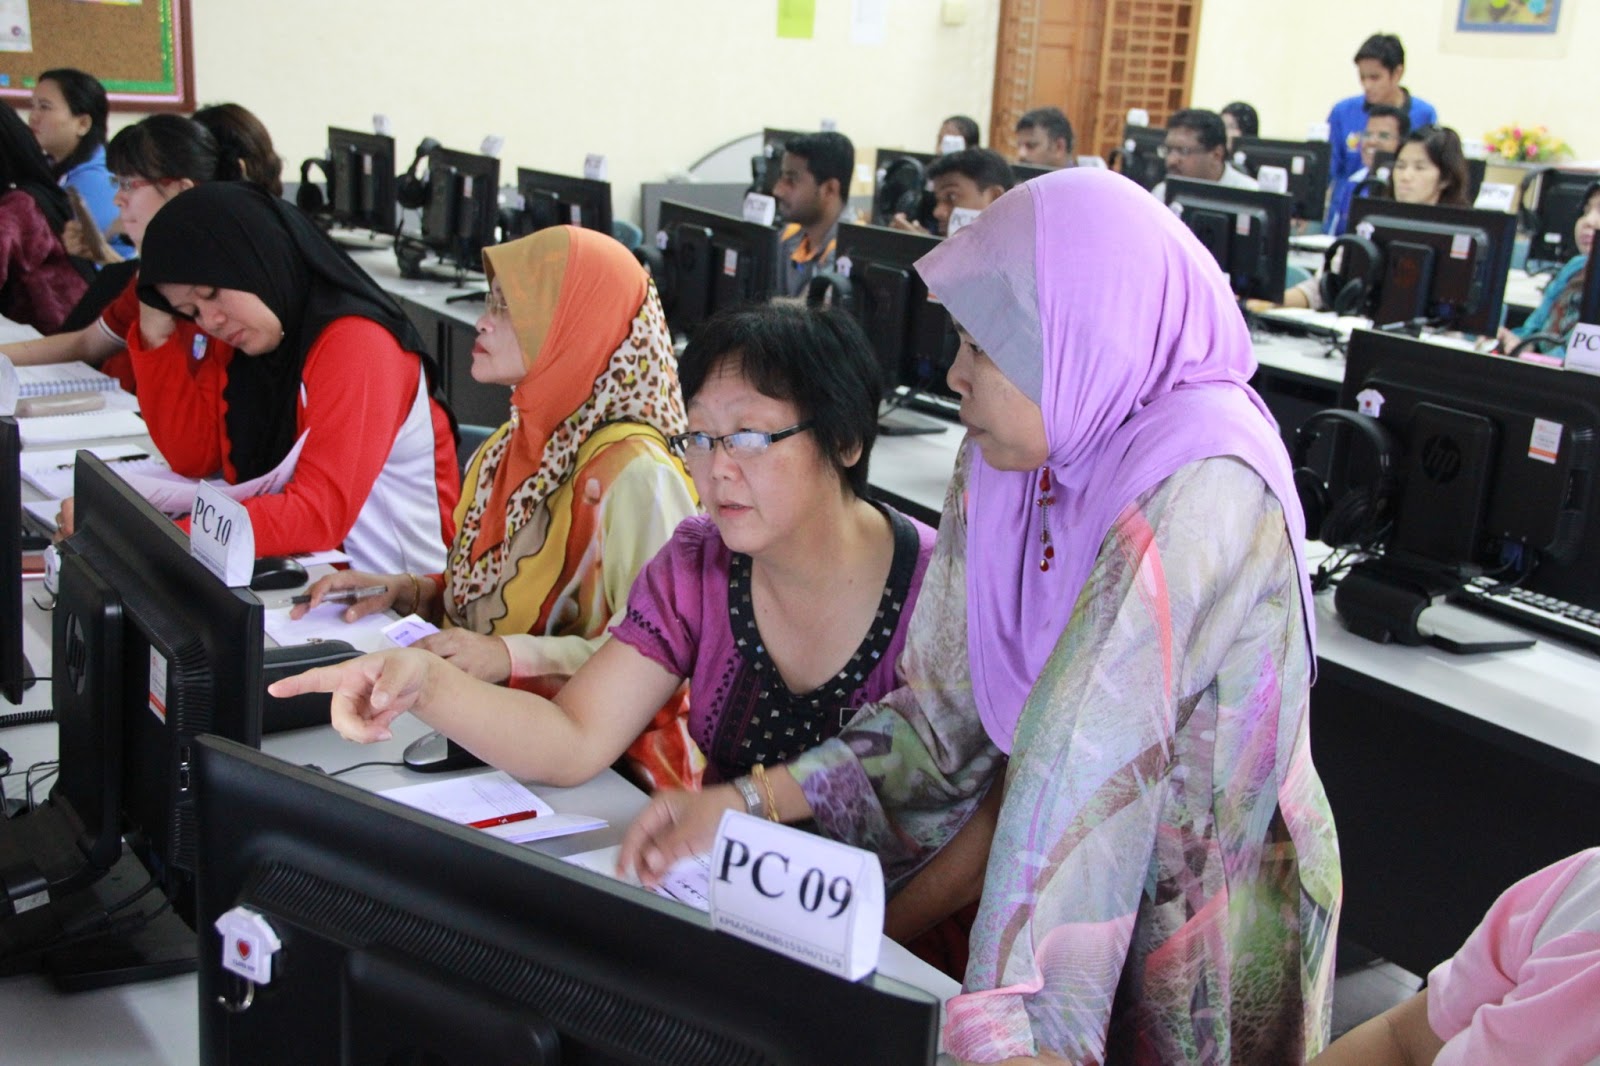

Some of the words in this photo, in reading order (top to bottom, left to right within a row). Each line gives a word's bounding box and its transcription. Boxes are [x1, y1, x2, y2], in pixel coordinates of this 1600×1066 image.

[1571, 331, 1600, 352] PC
[193, 495, 216, 534] PC
[214, 515, 232, 547] 10
[716, 836, 790, 899] PC
[799, 867, 853, 919] 09
